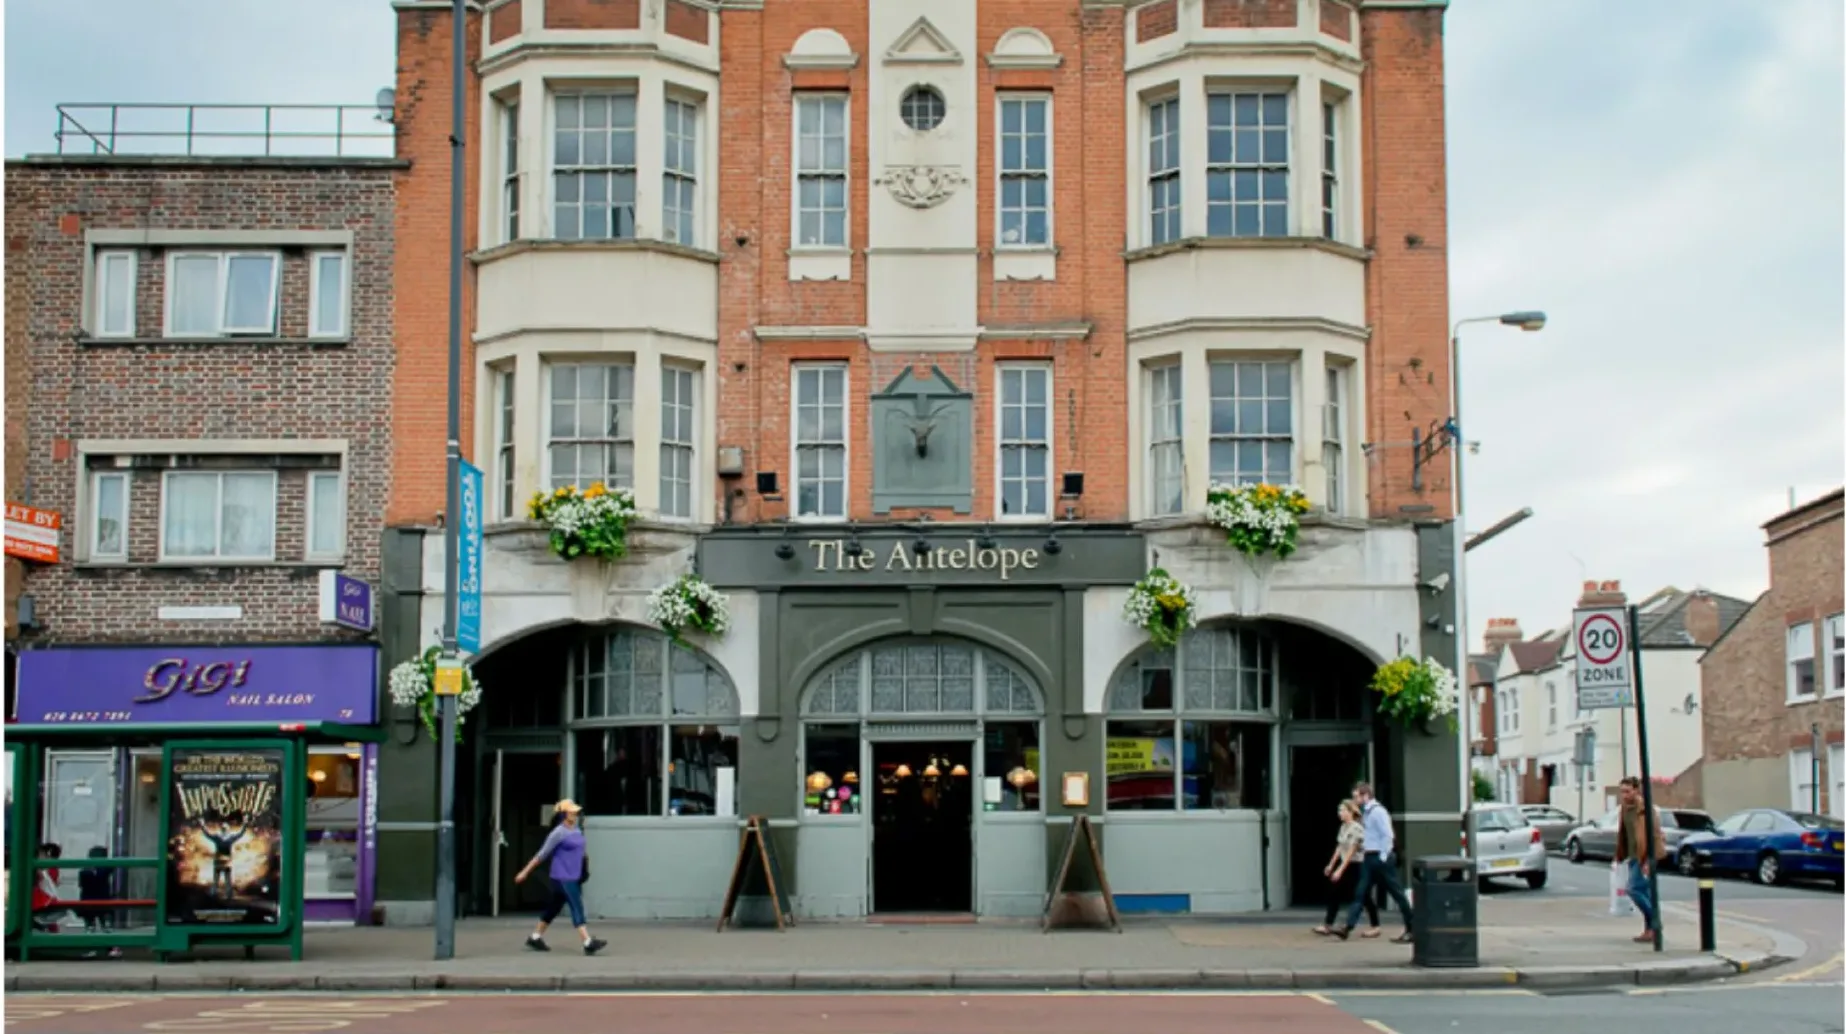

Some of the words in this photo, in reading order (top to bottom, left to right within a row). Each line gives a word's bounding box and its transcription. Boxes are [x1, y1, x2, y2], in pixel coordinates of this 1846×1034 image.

[35, 511, 55, 527] BY
[809, 539, 876, 570] The
[884, 539, 1039, 580] Antelope
[1586, 628, 1618, 650] 20
[1583, 666, 1624, 682] ZONE
[227, 693, 260, 706] NAIL
[264, 693, 316, 706] SALON
